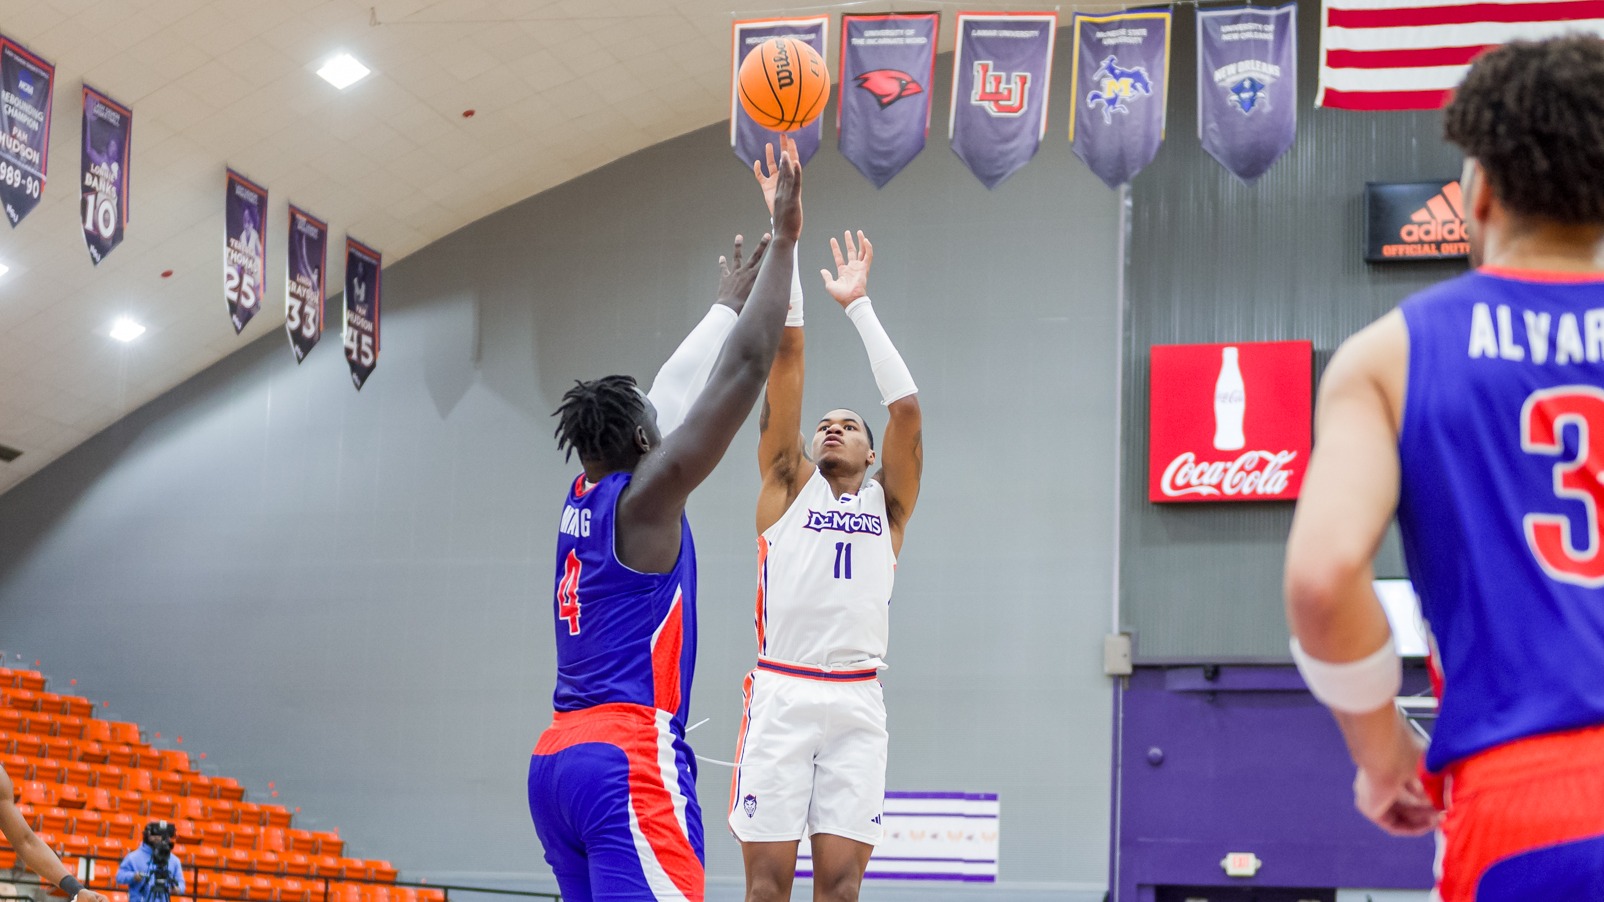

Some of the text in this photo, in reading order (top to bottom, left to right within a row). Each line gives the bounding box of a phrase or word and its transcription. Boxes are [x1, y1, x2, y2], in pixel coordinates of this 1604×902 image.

[1128, 28, 1147, 36] STATE
[970, 60, 1031, 117] LU
[1105, 78, 1131, 98] M
[1214, 60, 1280, 82] NEW ORLEANS
[4, 104, 39, 131] CHAMPION
[84, 172, 117, 200] BANKS
[84, 193, 115, 238] 10
[1382, 243, 1438, 257] OFFICIAL
[225, 265, 256, 309] 25
[287, 297, 316, 338] 33
[345, 326, 374, 368] 45
[1161, 450, 1297, 496] Coca-Cola
[803, 510, 882, 536] DEMONS
[834, 542, 852, 579] 11
[557, 548, 582, 636] 4
